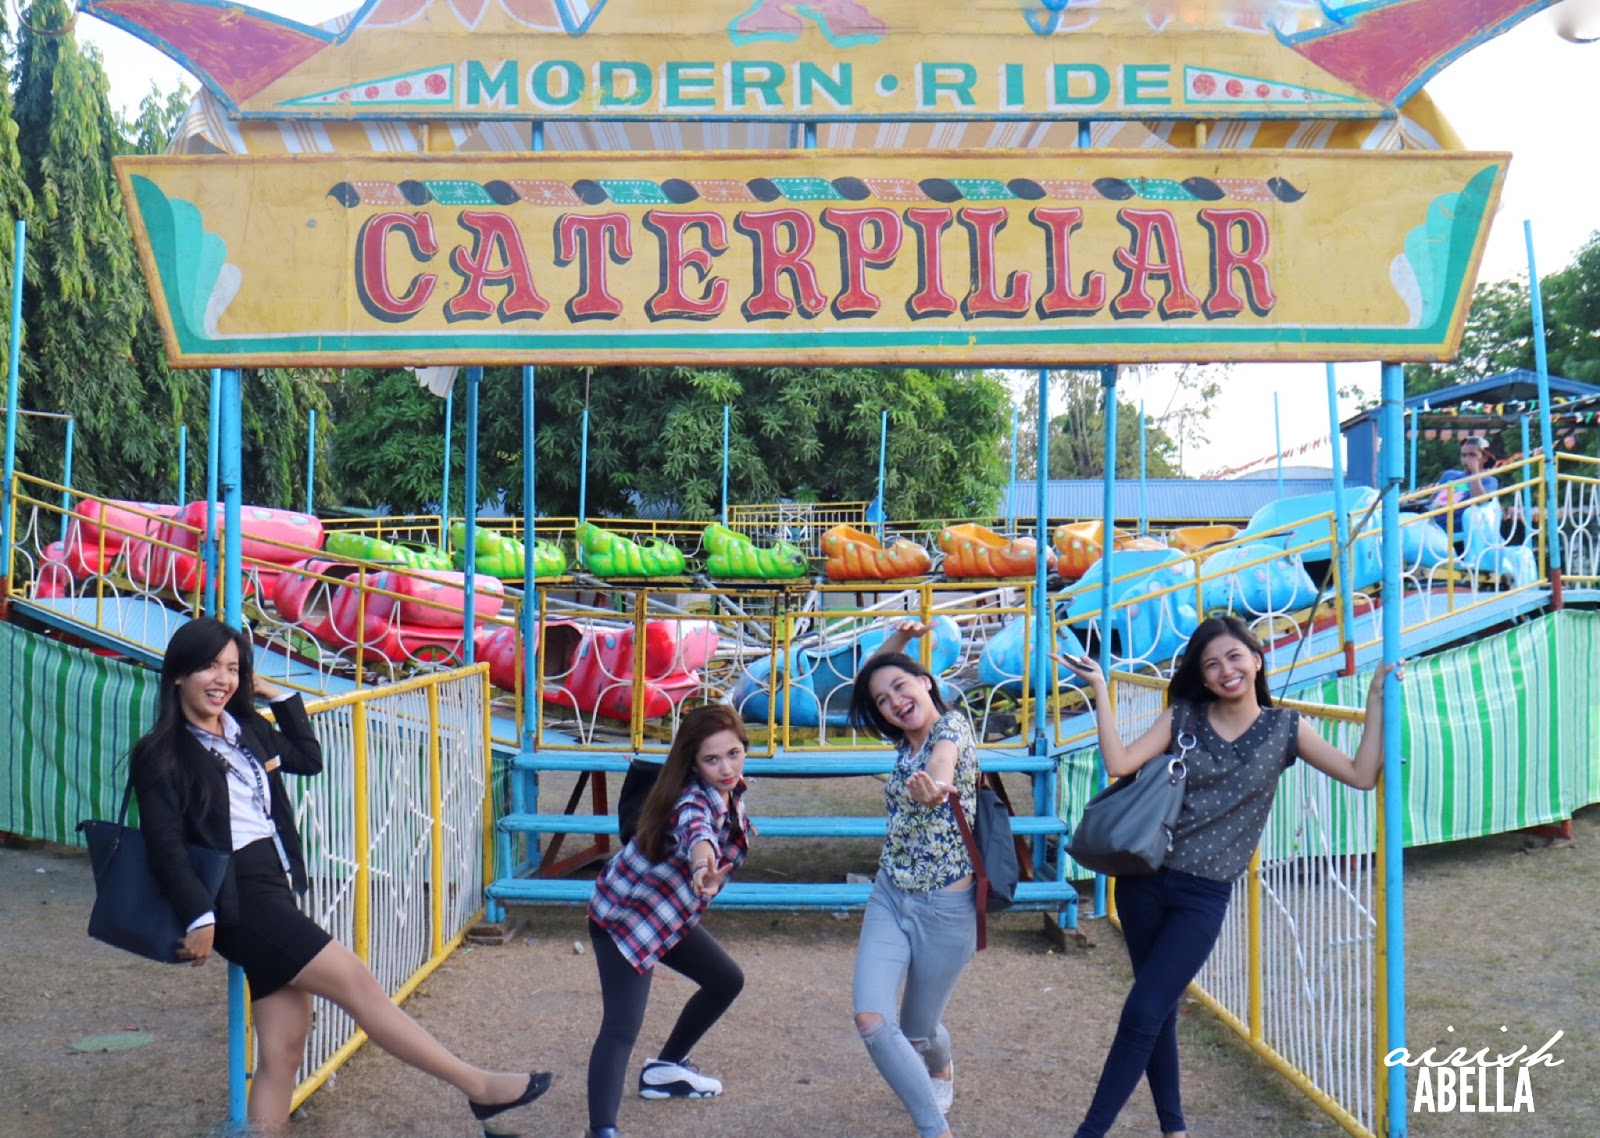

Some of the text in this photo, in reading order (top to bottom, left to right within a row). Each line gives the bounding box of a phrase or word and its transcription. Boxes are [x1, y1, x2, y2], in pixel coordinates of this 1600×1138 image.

[462, 59, 1173, 112] MODERN RIDE
[354, 206, 1278, 324] CATERPILLAR
